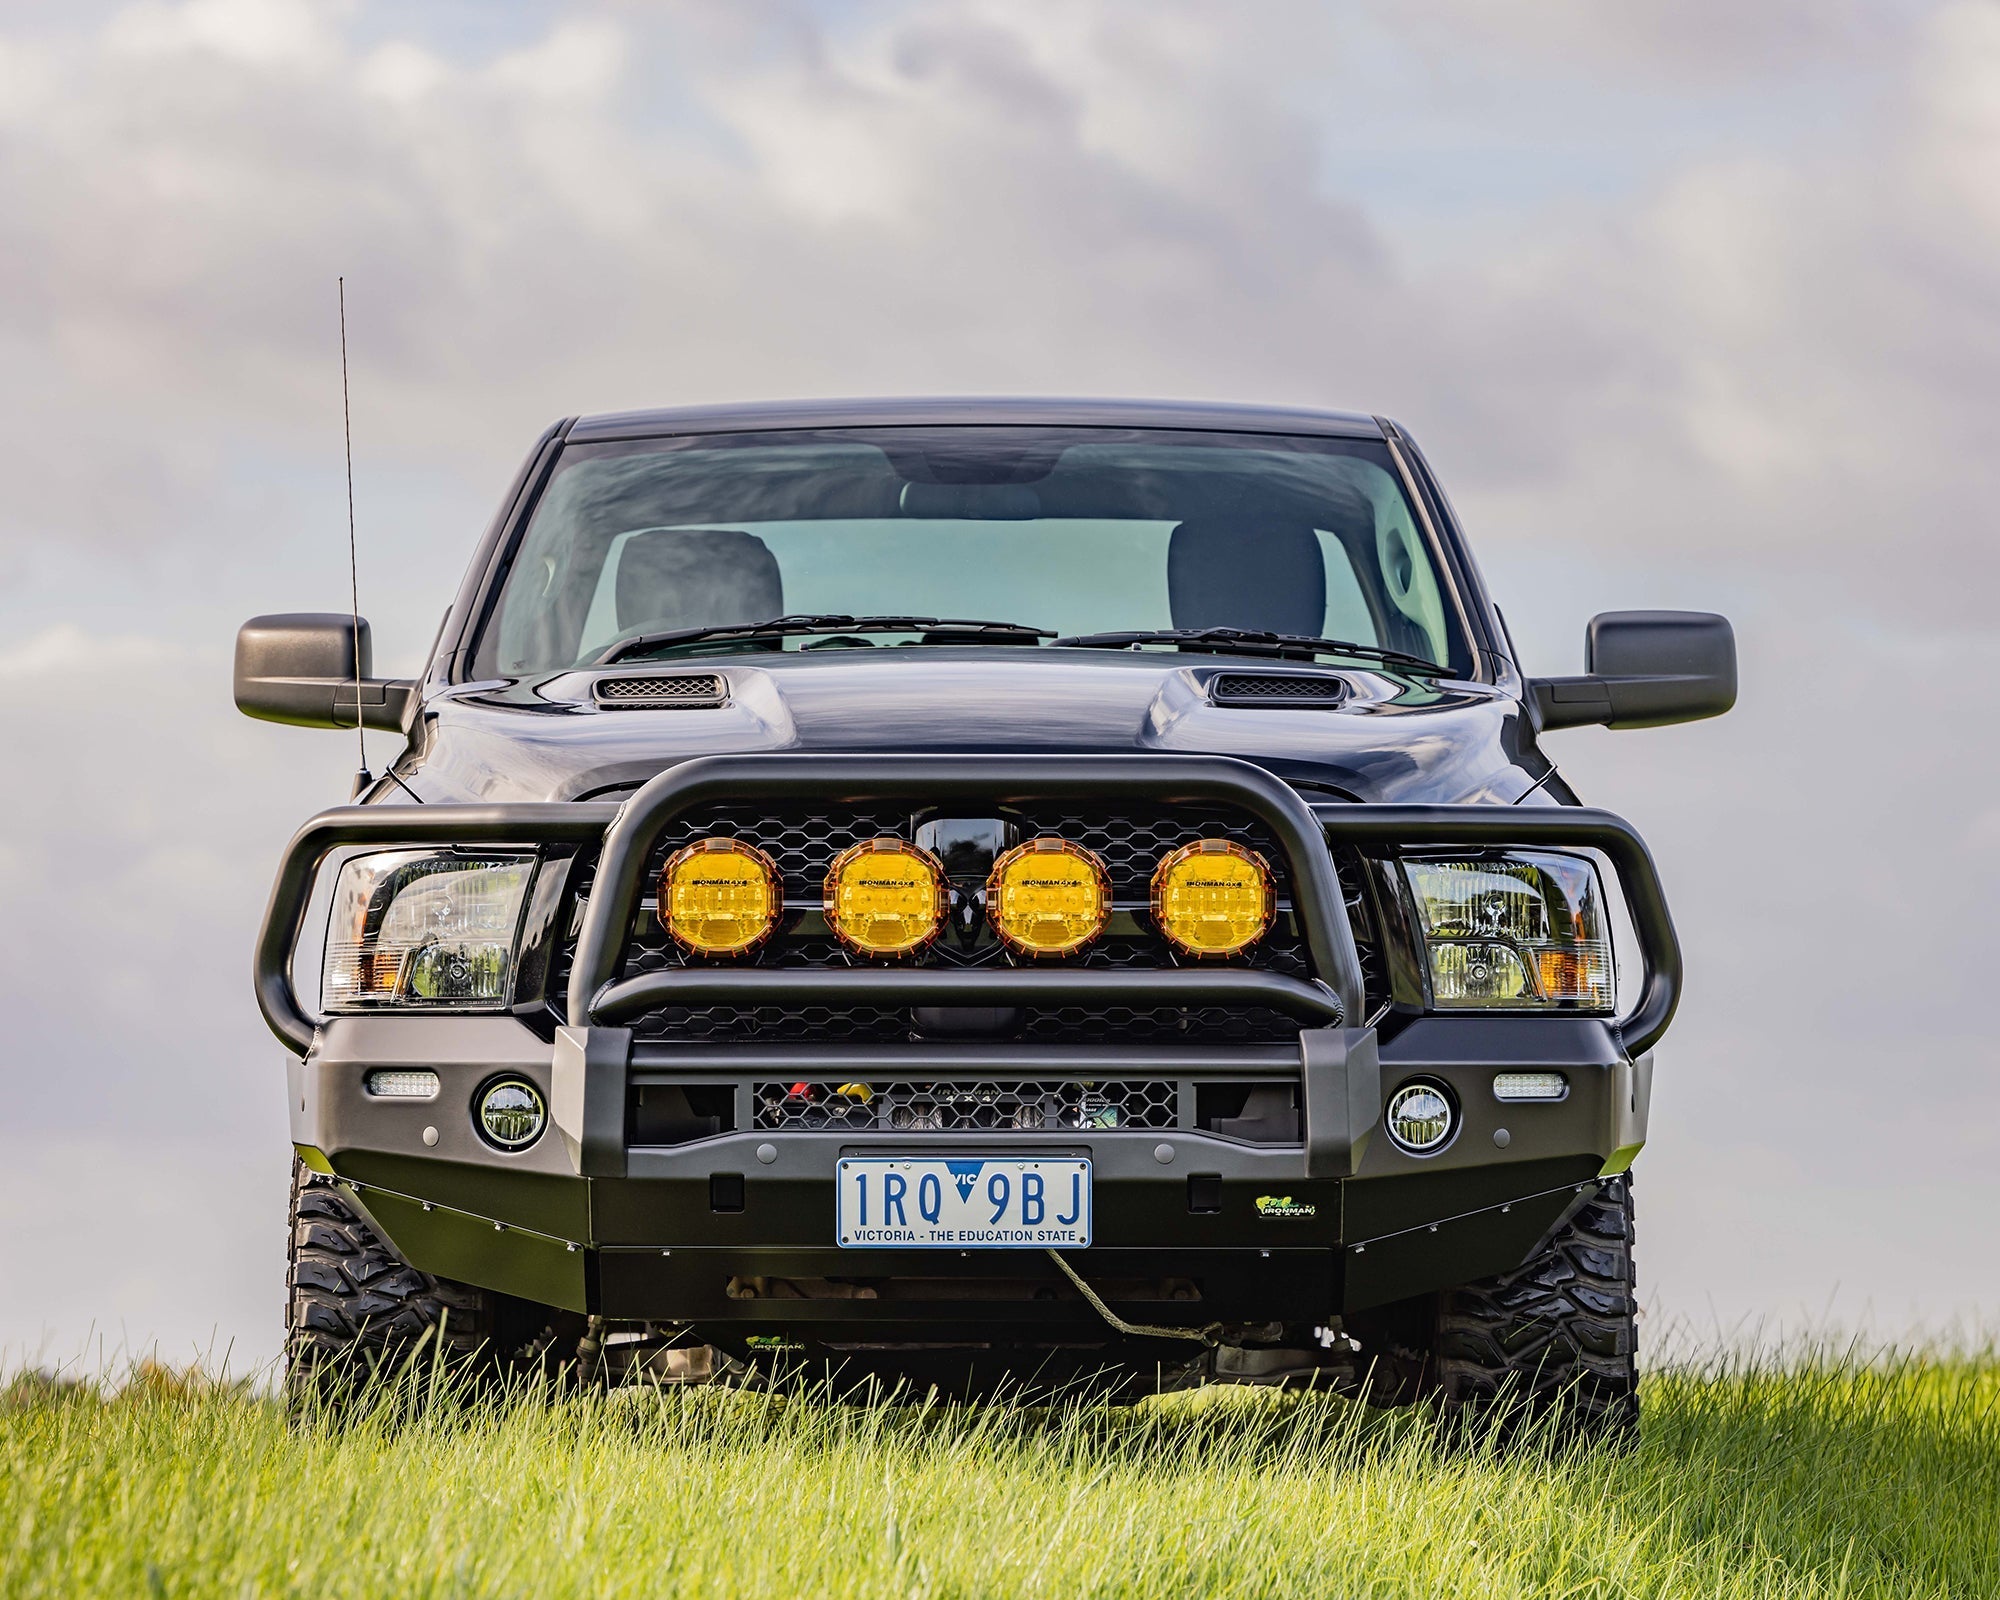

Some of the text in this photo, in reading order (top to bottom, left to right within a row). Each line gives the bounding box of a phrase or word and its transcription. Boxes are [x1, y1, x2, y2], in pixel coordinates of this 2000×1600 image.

[950, 1173, 977, 1185] VIC
[854, 1230, 915, 1241] VICTORIA
[929, 1230, 954, 1241] THE
[959, 1230, 1033, 1241] EDUCATION
[1037, 1230, 1076, 1241] STATE
